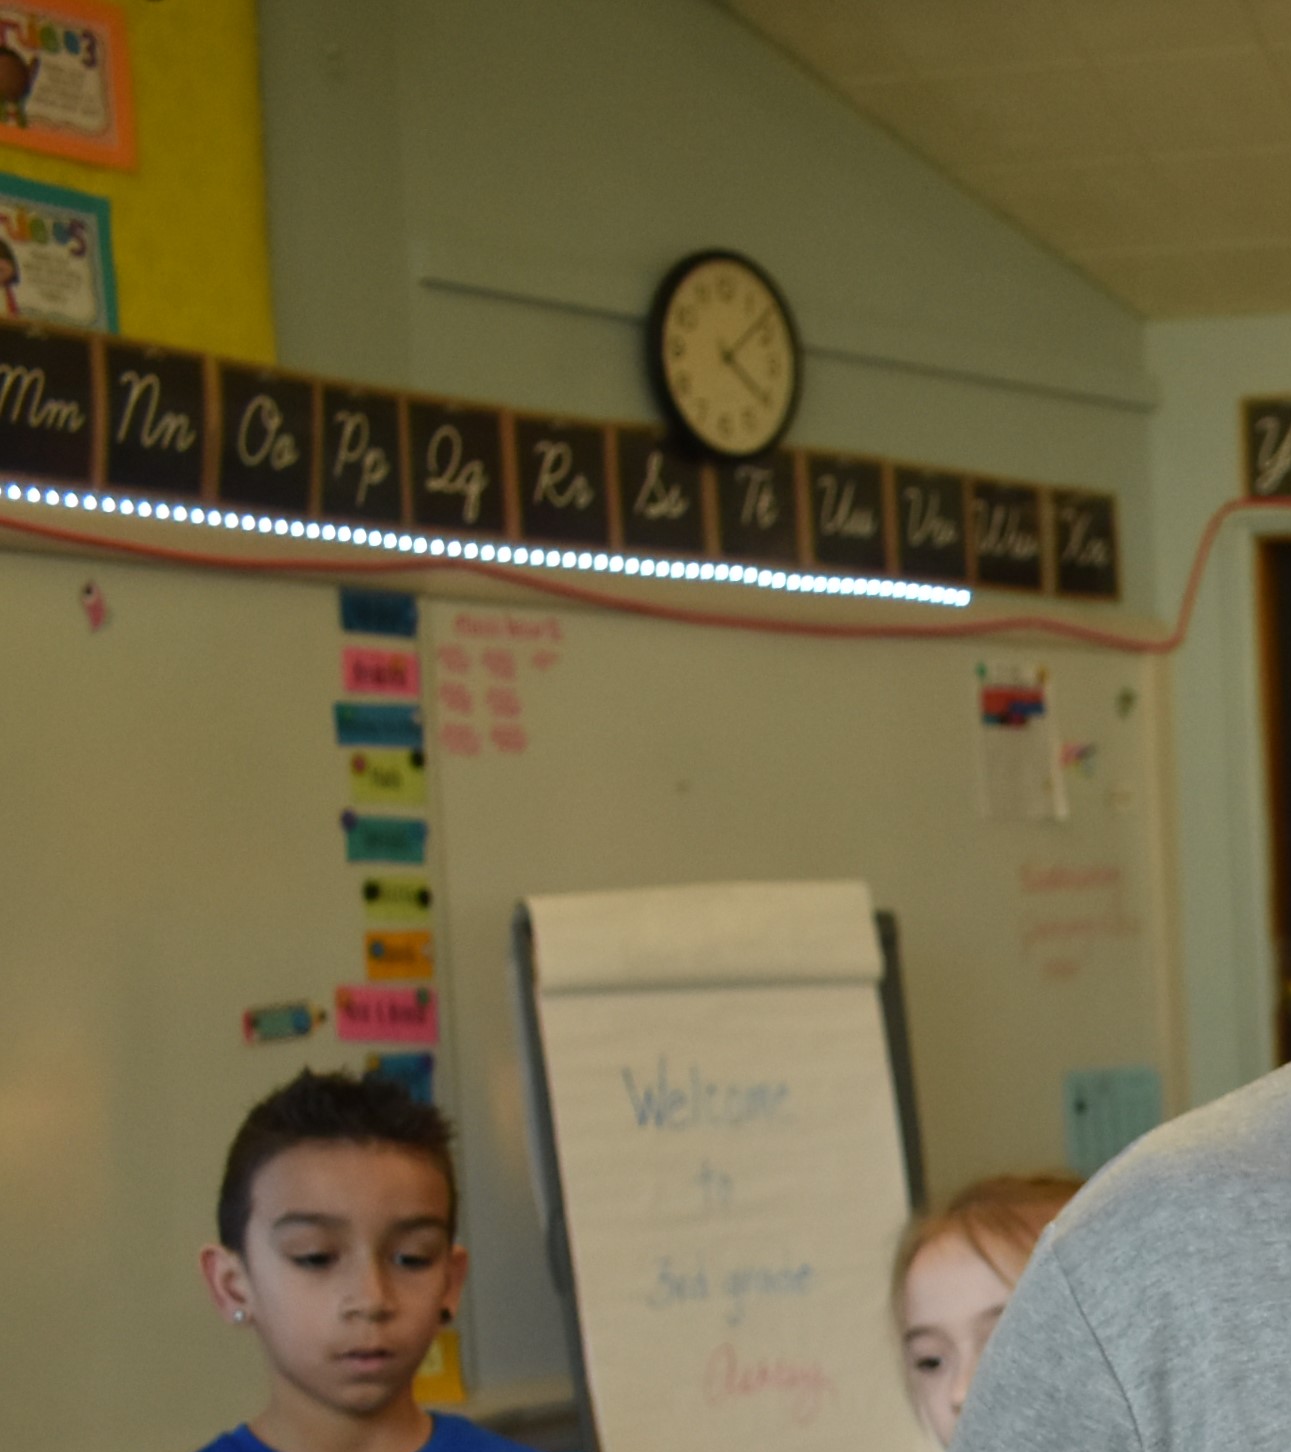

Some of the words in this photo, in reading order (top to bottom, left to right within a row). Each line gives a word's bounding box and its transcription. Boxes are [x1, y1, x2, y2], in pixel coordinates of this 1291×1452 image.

[119, 369, 197, 452] Nn
[236, 394, 300, 471] Oo
[333, 410, 391, 507] Pp
